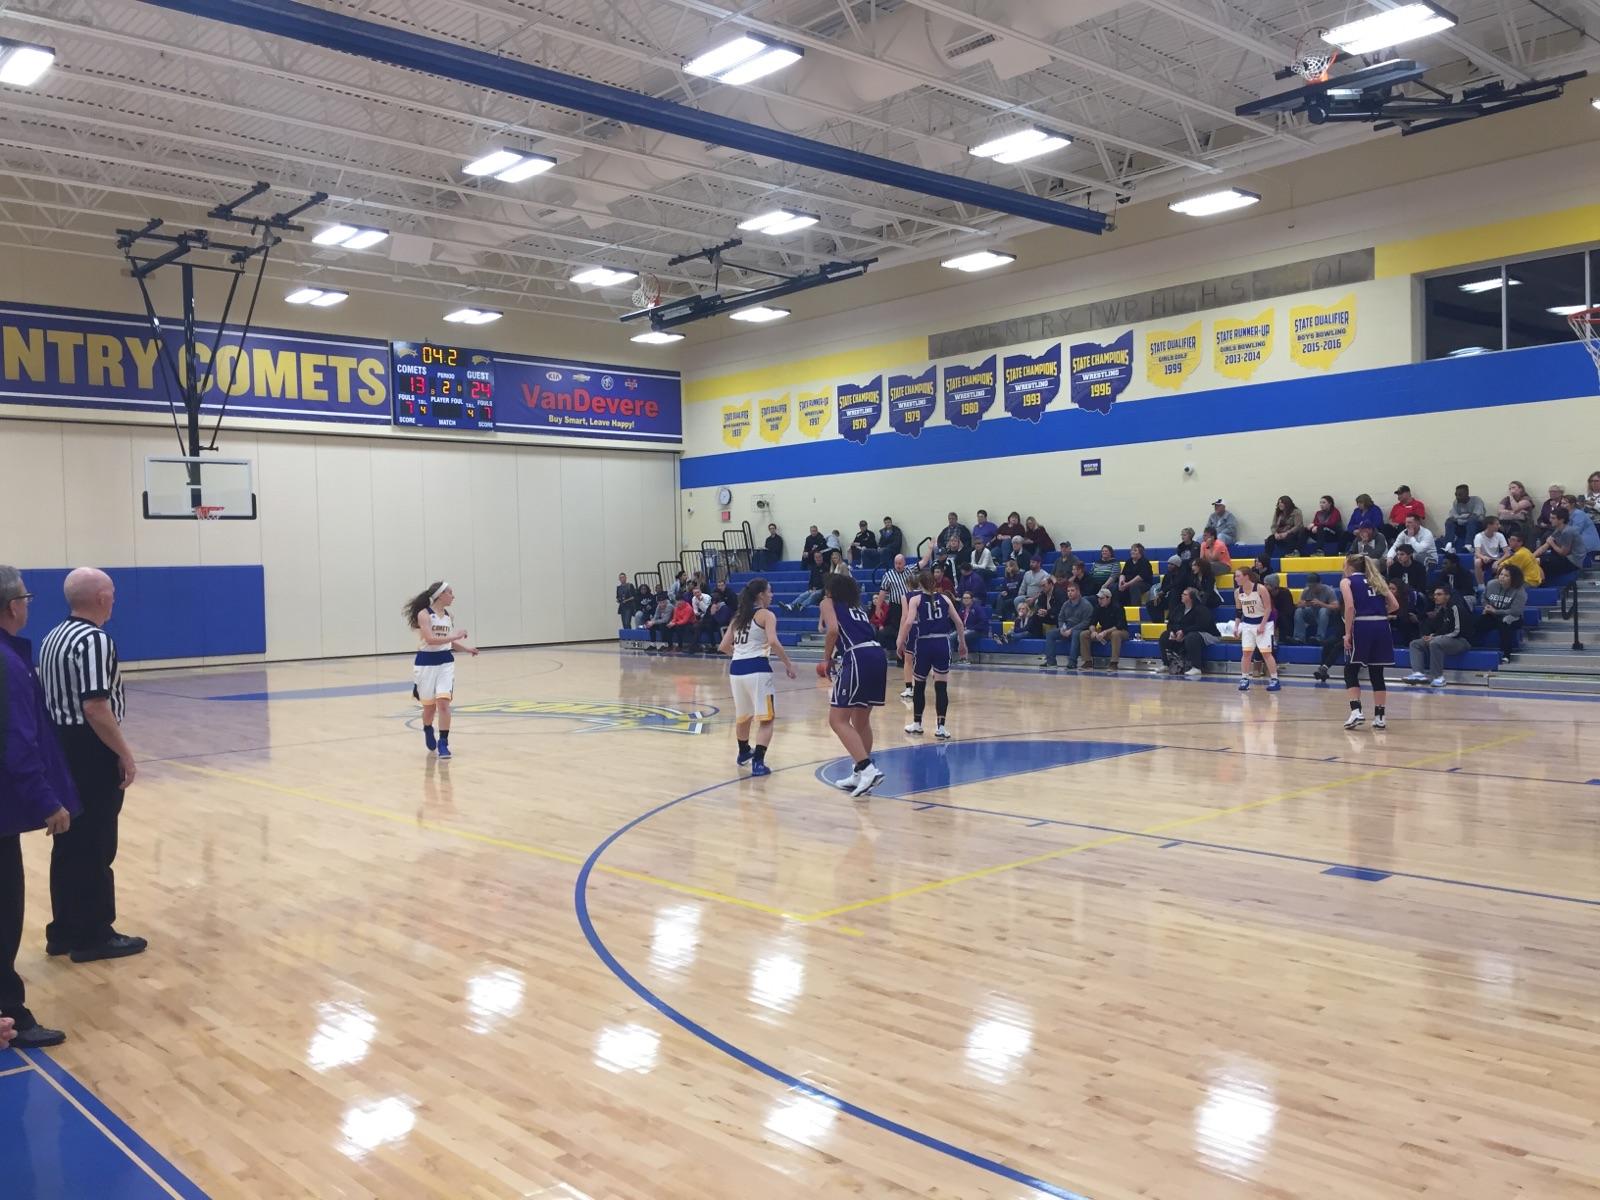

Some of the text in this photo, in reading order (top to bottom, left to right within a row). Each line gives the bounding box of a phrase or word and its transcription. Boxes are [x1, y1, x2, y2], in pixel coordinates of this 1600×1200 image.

[1295, 310, 1349, 333] STATE QUALIFIER
[1216, 324, 1270, 344] STATE RUNNER-UP
[1297, 327, 1346, 341] BOYS BOWLING
[1150, 335, 1196, 355] STATE QUALIFIER
[1237, 341, 1266, 351] BOWLING
[1302, 339, 1341, 354] 2015-2016
[422, 346, 457, 366] 04.2
[1072, 349, 1129, 373] STATE CHAMPIONS
[1224, 351, 1261, 365] 2013-2014
[2, 326, 387, 406] NTRY COMETS
[397, 364, 427, 375] COMETS
[1006, 361, 1057, 383] STATE CHAMPIONS
[1164, 362, 1182, 375] 1999
[466, 370, 490, 380] GUEST
[1082, 369, 1120, 380] WRESTLING
[410, 376, 426, 394] 13
[442, 380, 450, 394] 2
[946, 372, 993, 392] STATE CHAMPIONS
[1014, 380, 1048, 391] WRESTLING
[471, 381, 492, 399] 24
[890, 381, 934, 401] STATE CHAMPIONS
[954, 390, 985, 400] WRESTLING
[1090, 382, 1111, 397] 1996
[398, 393, 415, 401] FOULS
[431, 396, 463, 405] PLAYER FOUL
[521, 383, 659, 418] VanDevere
[839, 390, 880, 409] STATE CHAMPIONS
[1023, 393, 1041, 407] 1993
[405, 401, 414, 414] 7
[420, 406, 427, 414] 4
[467, 409, 474, 417] 4
[484, 407, 492, 419] 7
[961, 402, 979, 415] 1980
[399, 416, 416, 424] SCORE
[548, 414, 635, 430] Buy Smart, Leave Happy!
[904, 410, 921, 423] 1979
[852, 418, 867, 430] 1978
[925, 600, 942, 620] 15
